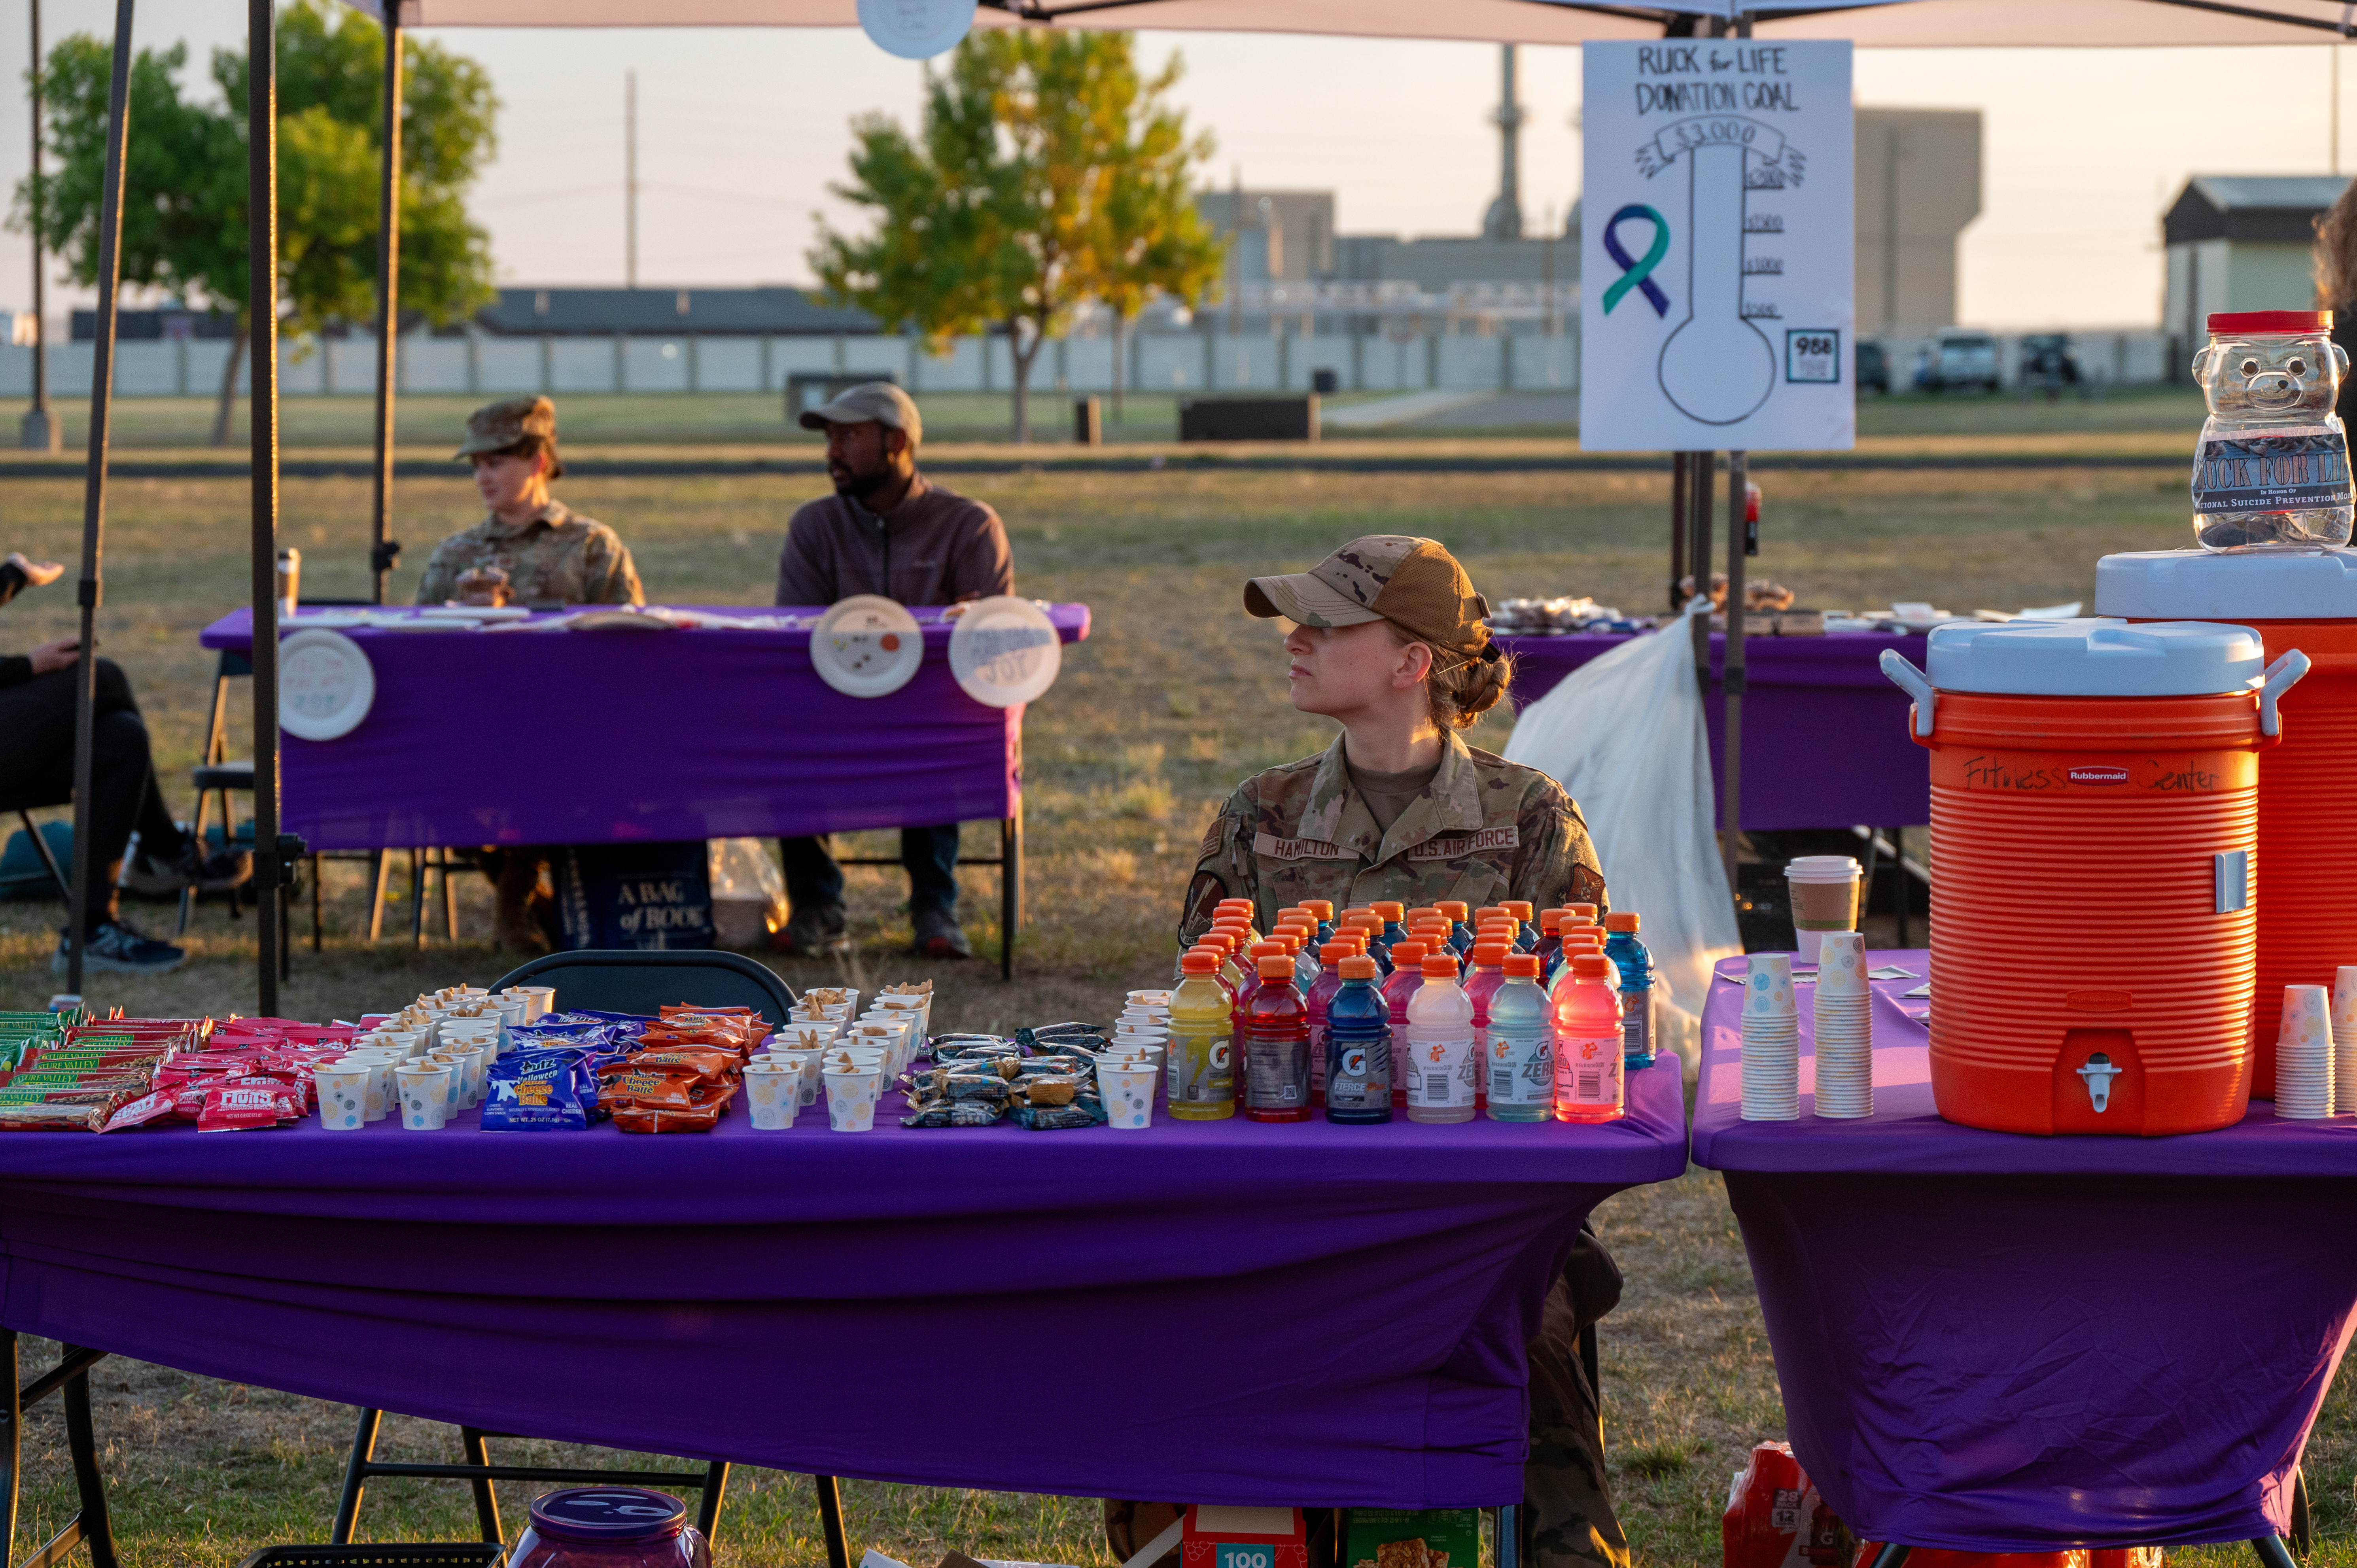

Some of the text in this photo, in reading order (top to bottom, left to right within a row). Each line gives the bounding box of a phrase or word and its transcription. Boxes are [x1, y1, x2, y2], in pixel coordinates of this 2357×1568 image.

[1638, 45, 1701, 74] RUCK
[1738, 46, 1788, 74] LIFE
[1636, 81, 1801, 115] DONATION GOAL
[1796, 337, 1832, 355] 988
[2258, 454, 2310, 486] FOR
[2316, 452, 2350, 483] LIF
[1964, 756, 2220, 791] Fitness Center
[2070, 772, 2126, 780] Rubbermaid
[1275, 839, 1339, 857] HAMILTON
[1443, 838, 1464, 855] AIR
[1466, 828, 1514, 851] FORCE
[617, 880, 685, 905] A BAG
[1342, 1048, 1366, 1076] G
[1521, 1060, 1555, 1078] ZERO
[43, 1074, 75, 1083] VALLEY
[623, 1076, 660, 1086] Cheese
[515, 1084, 553, 1095] Cheese
[627, 1085, 654, 1094] Balls
[1335, 1083, 1366, 1091] FIERCE
[9, 1093, 42, 1102] VALLEY
[519, 1094, 548, 1105] Balls
[1778, 1490, 1799, 1502] 28
[1776, 1510, 1795, 1523] 12
[1224, 1552, 1267, 1568] 100
